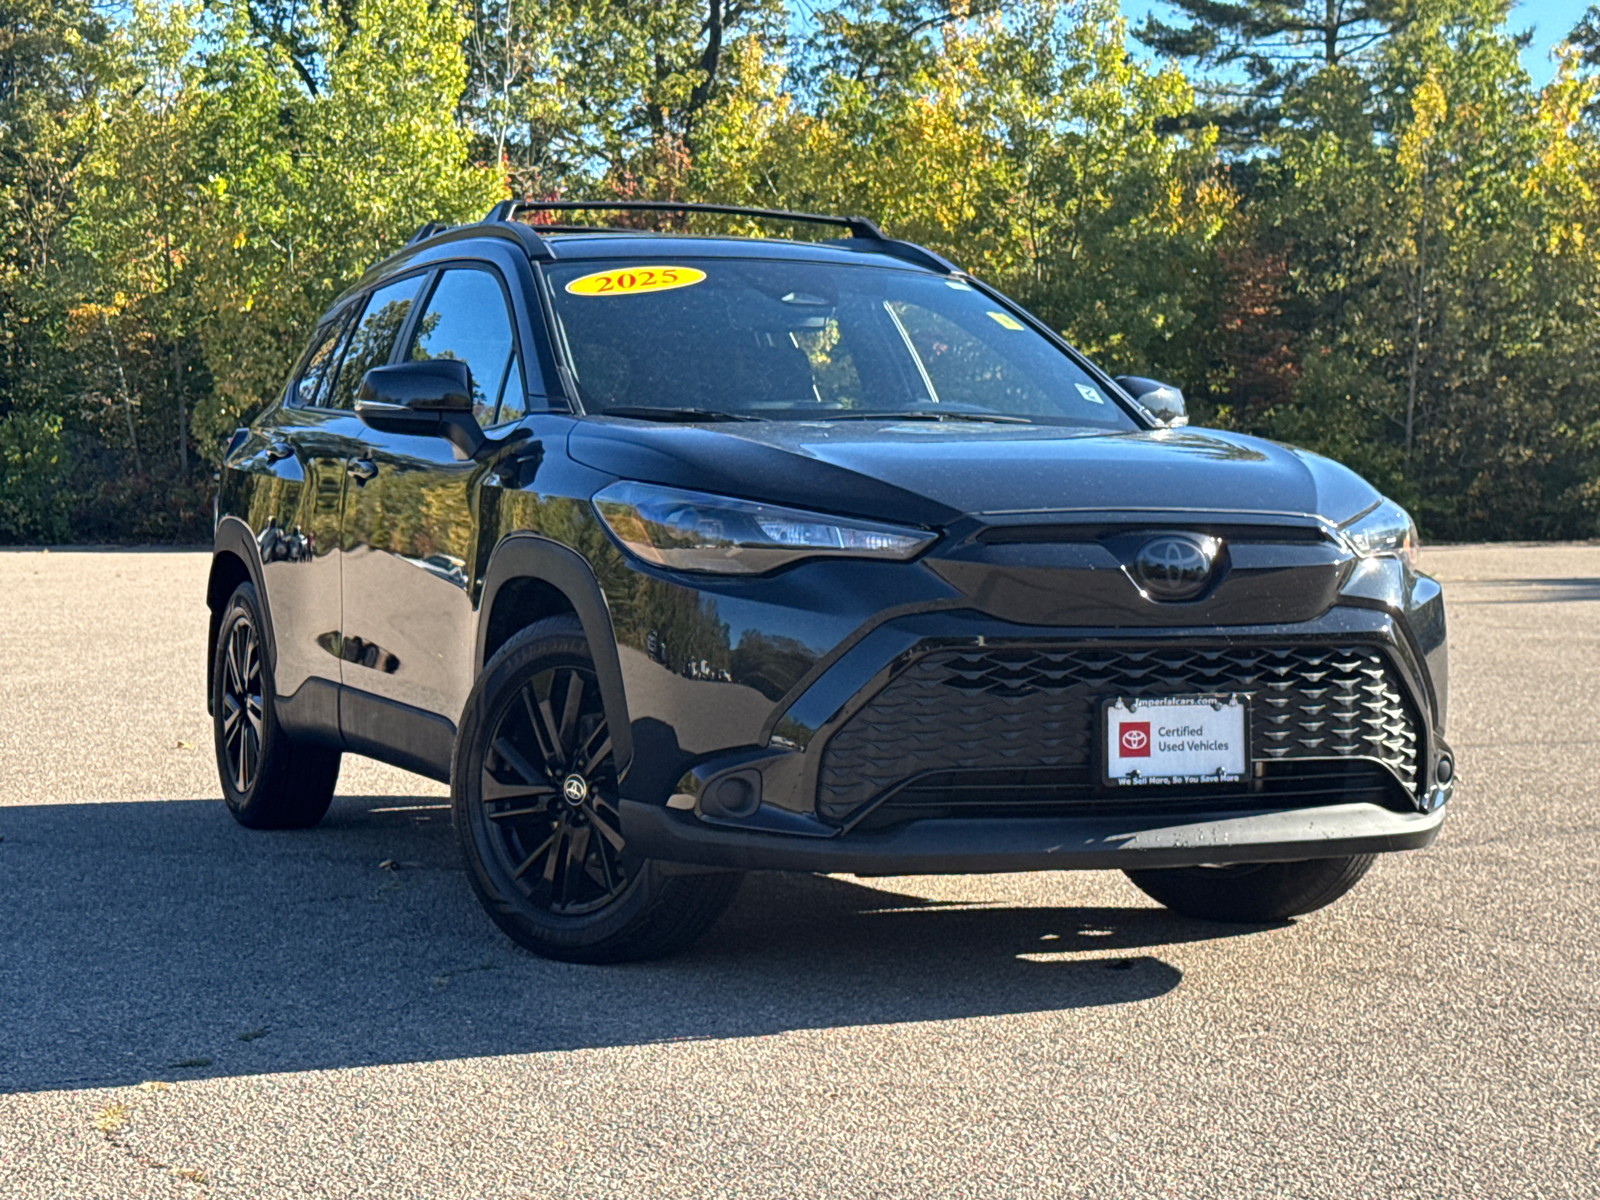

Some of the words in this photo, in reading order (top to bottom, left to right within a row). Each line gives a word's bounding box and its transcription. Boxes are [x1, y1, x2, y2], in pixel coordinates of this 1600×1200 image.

[595, 269, 678, 292] 2025
[1158, 726, 1203, 737] Certified
[1158, 741, 1185, 752] Used
[1187, 740, 1229, 751] Vehicles
[1118, 778, 1131, 786] We
[1133, 777, 1147, 785] Sell
[1149, 776, 1171, 785] More,
[1172, 776, 1182, 784] So
[1185, 775, 1199, 784] You
[1201, 775, 1219, 783] Save
[1220, 774, 1239, 782] More
